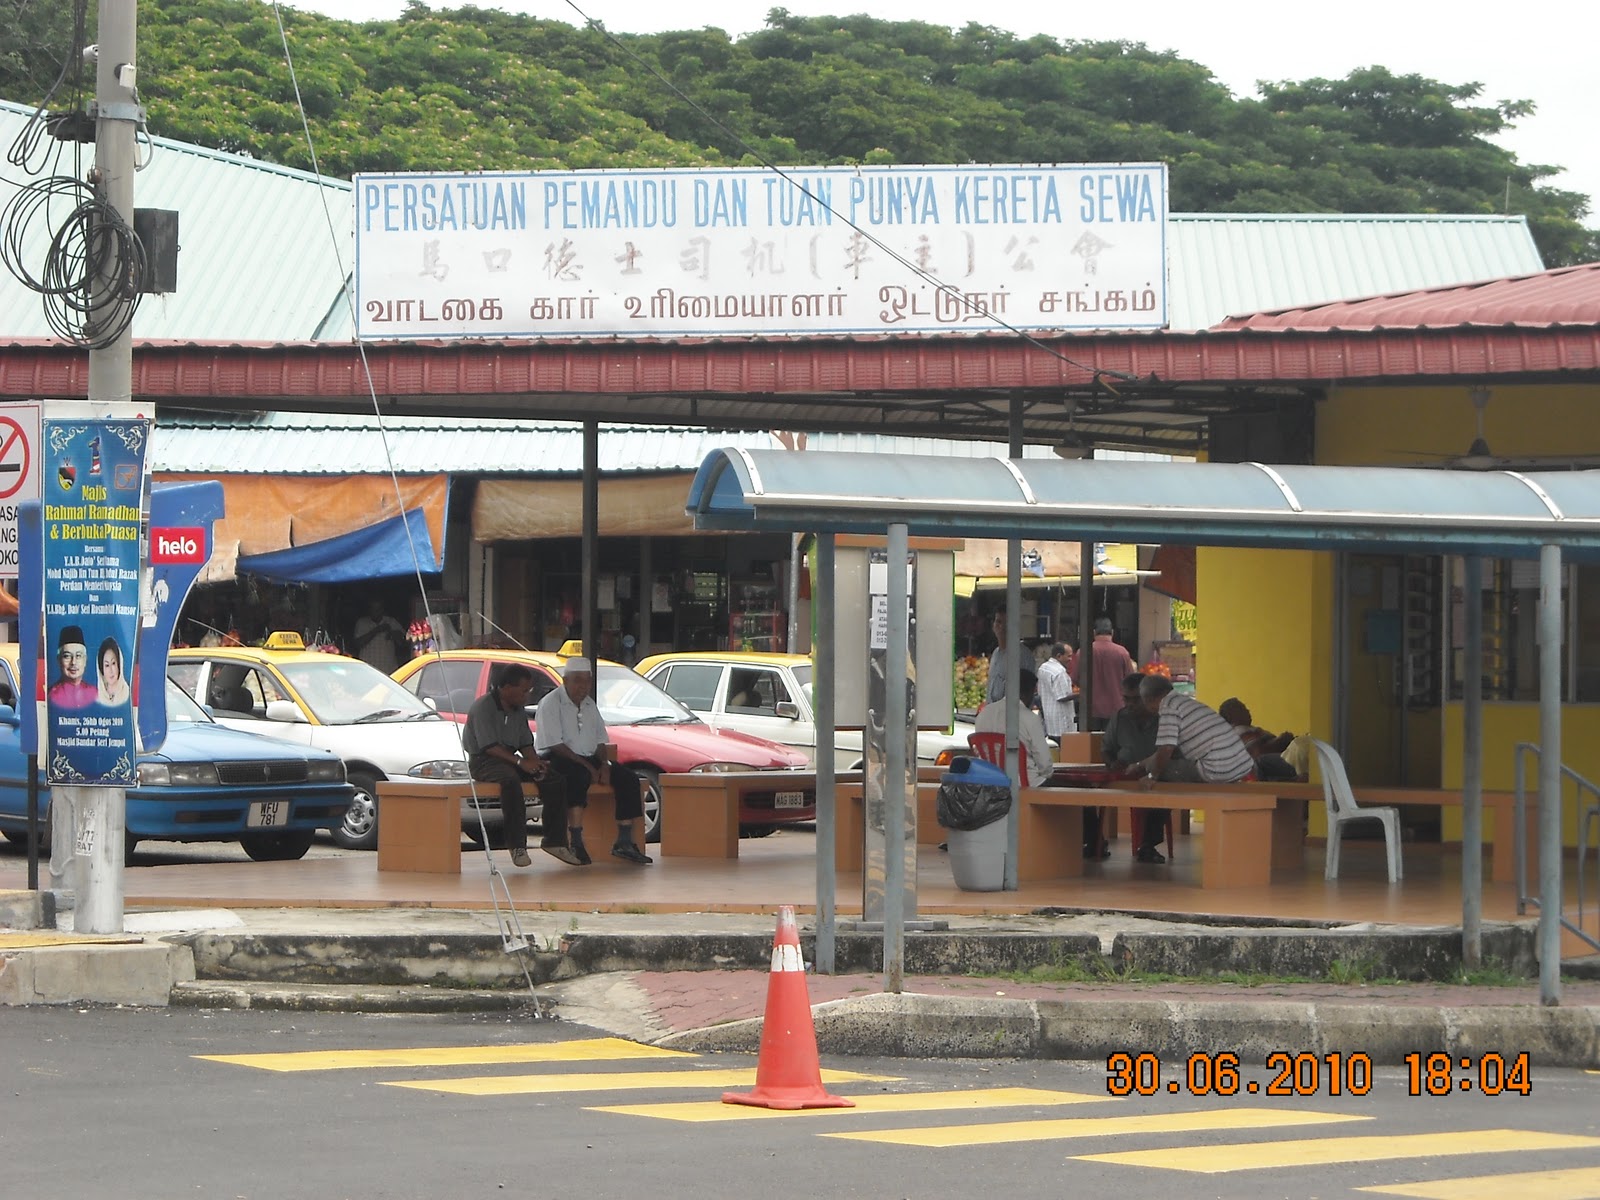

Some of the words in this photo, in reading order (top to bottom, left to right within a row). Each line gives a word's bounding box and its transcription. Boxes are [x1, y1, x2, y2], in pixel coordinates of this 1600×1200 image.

[365, 182, 526, 232] PERSATUAN
[544, 178, 677, 230] PEMANDU
[694, 178, 747, 227] DAN
[763, 177, 832, 227] TUAN
[850, 176, 940, 225] PUNYA
[956, 175, 1062, 224] KERETA
[1079, 173, 1156, 222] SEWA
[366, 298, 503, 322] வாடகை
[530, 289, 600, 320] கார்
[624, 286, 848, 319] உரிமையாளர்
[1038, 282, 1156, 313] சங்கம்
[81, 485, 107, 502] Majlis
[50, 524, 59, 539] &
[158, 536, 197, 555] helo
[260, 802, 279, 814] WFU
[260, 814, 276, 826] 781
